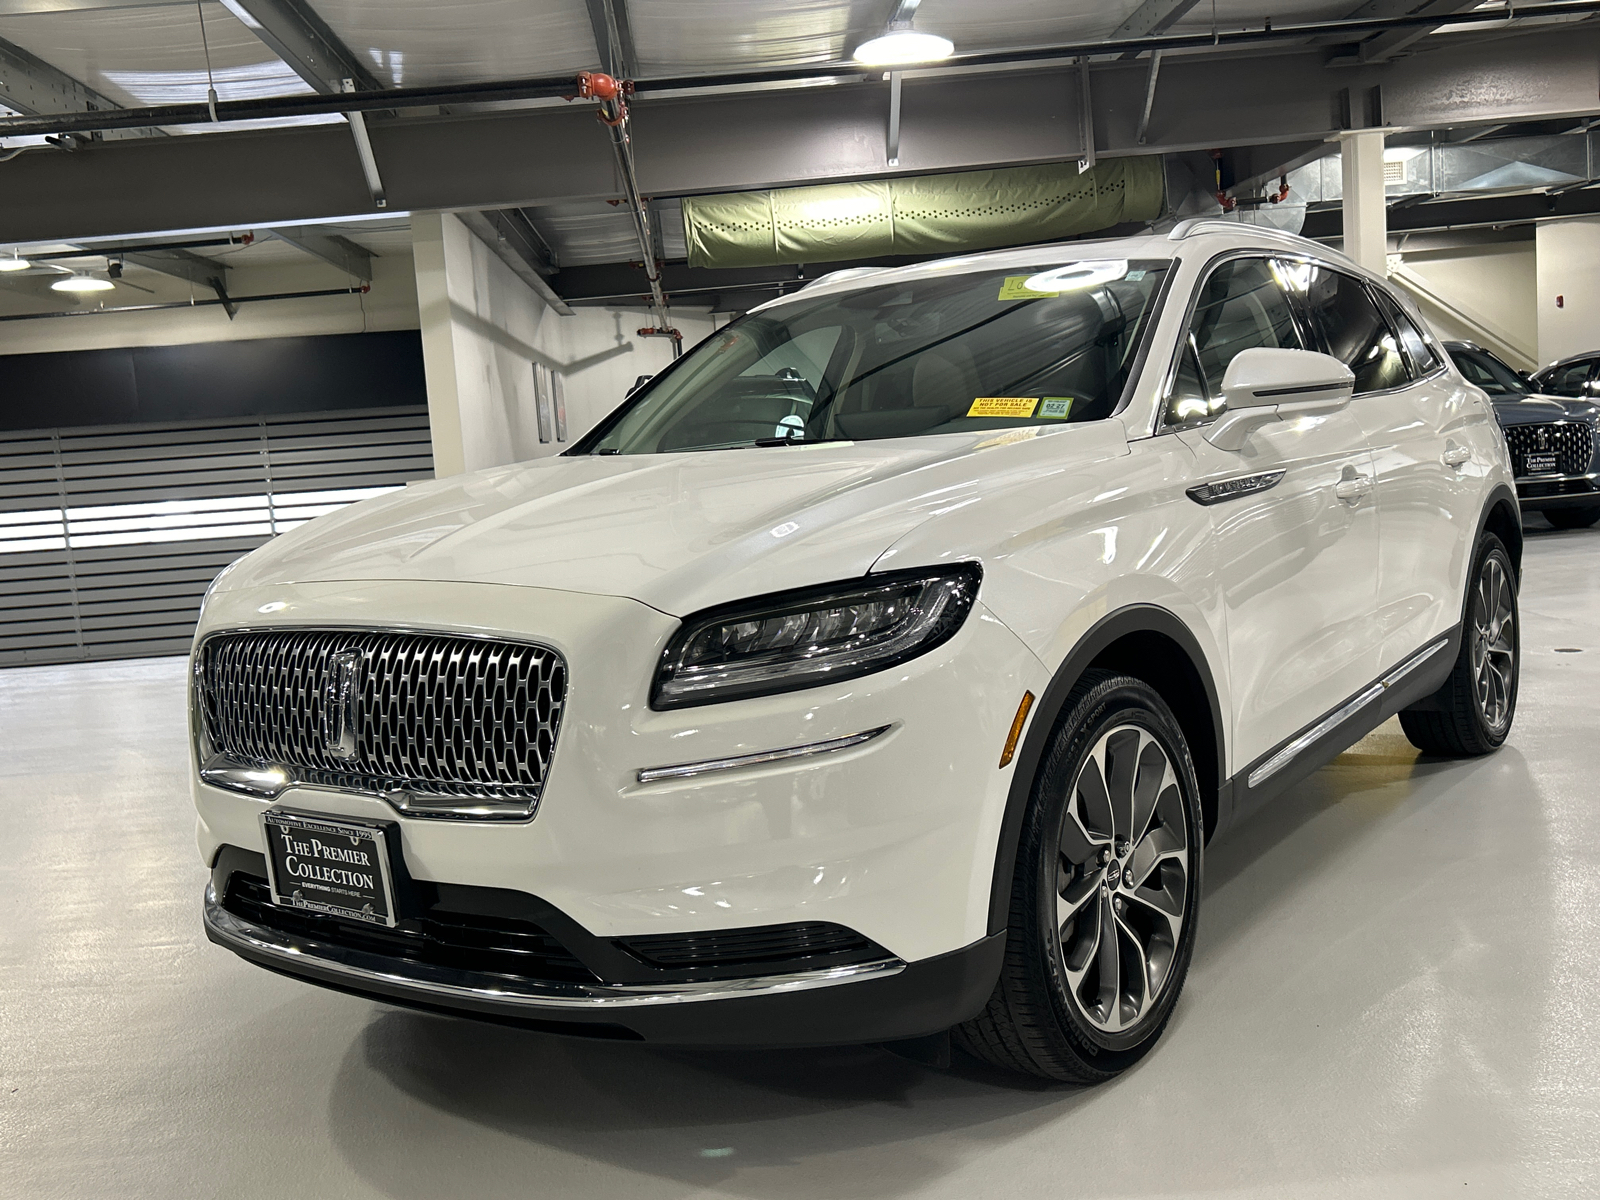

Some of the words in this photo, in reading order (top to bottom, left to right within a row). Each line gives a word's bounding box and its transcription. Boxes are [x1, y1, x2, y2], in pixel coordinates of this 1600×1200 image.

[1087, 701, 1107, 727] SPORT
[267, 816, 301, 827] AUTOMOTIVE
[303, 822, 336, 833] EXCELLENCE
[338, 827, 354, 836] SINCE
[356, 829, 372, 839] 1995
[281, 834, 311, 856] THE
[310, 838, 371, 867] PREMIER
[285, 855, 374, 890] COLLECTION
[301, 881, 331, 892] EVERYTHING
[331, 887, 348, 896] STARTS
